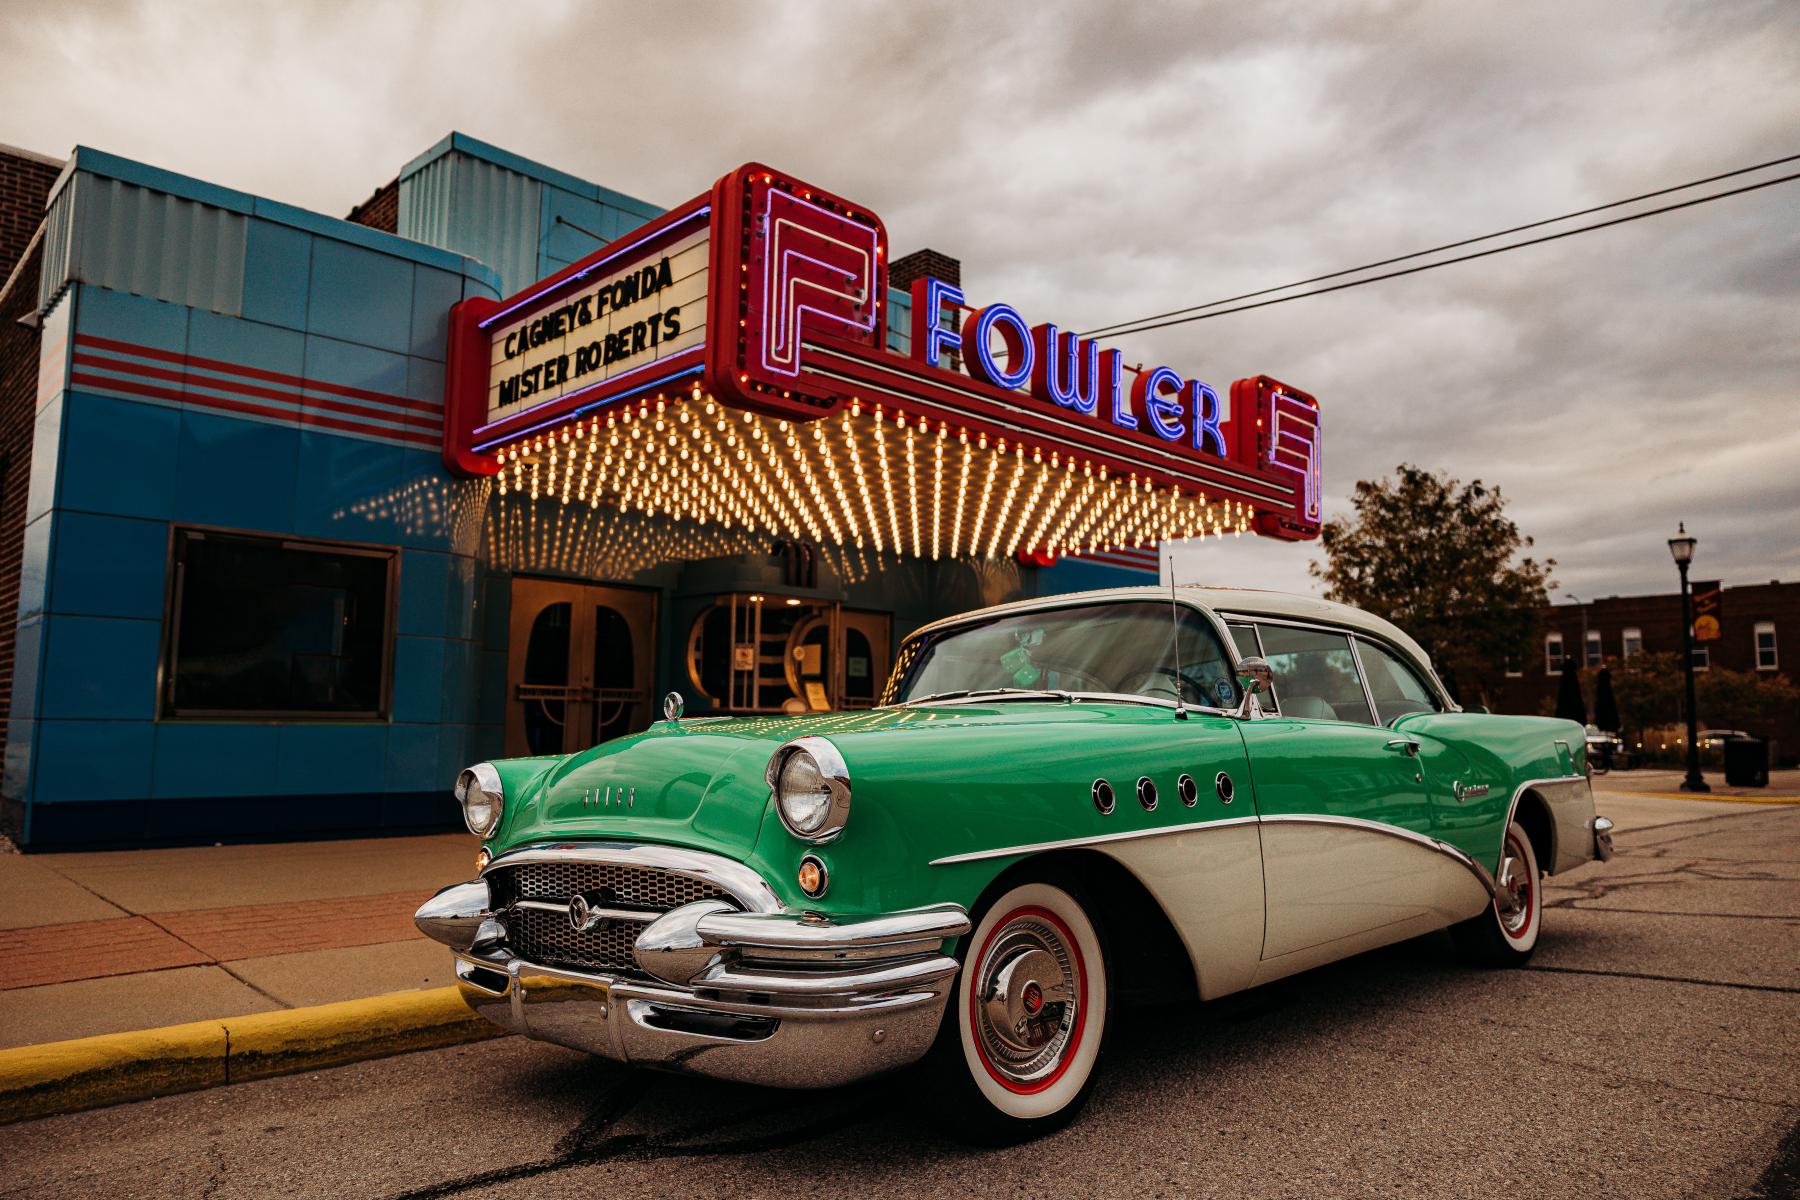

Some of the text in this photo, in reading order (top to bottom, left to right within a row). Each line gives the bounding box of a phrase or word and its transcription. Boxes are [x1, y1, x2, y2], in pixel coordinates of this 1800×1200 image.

[596, 256, 673, 319] FONDA
[498, 306, 681, 408] MISTER ROBERTS
[922, 276, 1227, 459] FOWLER
